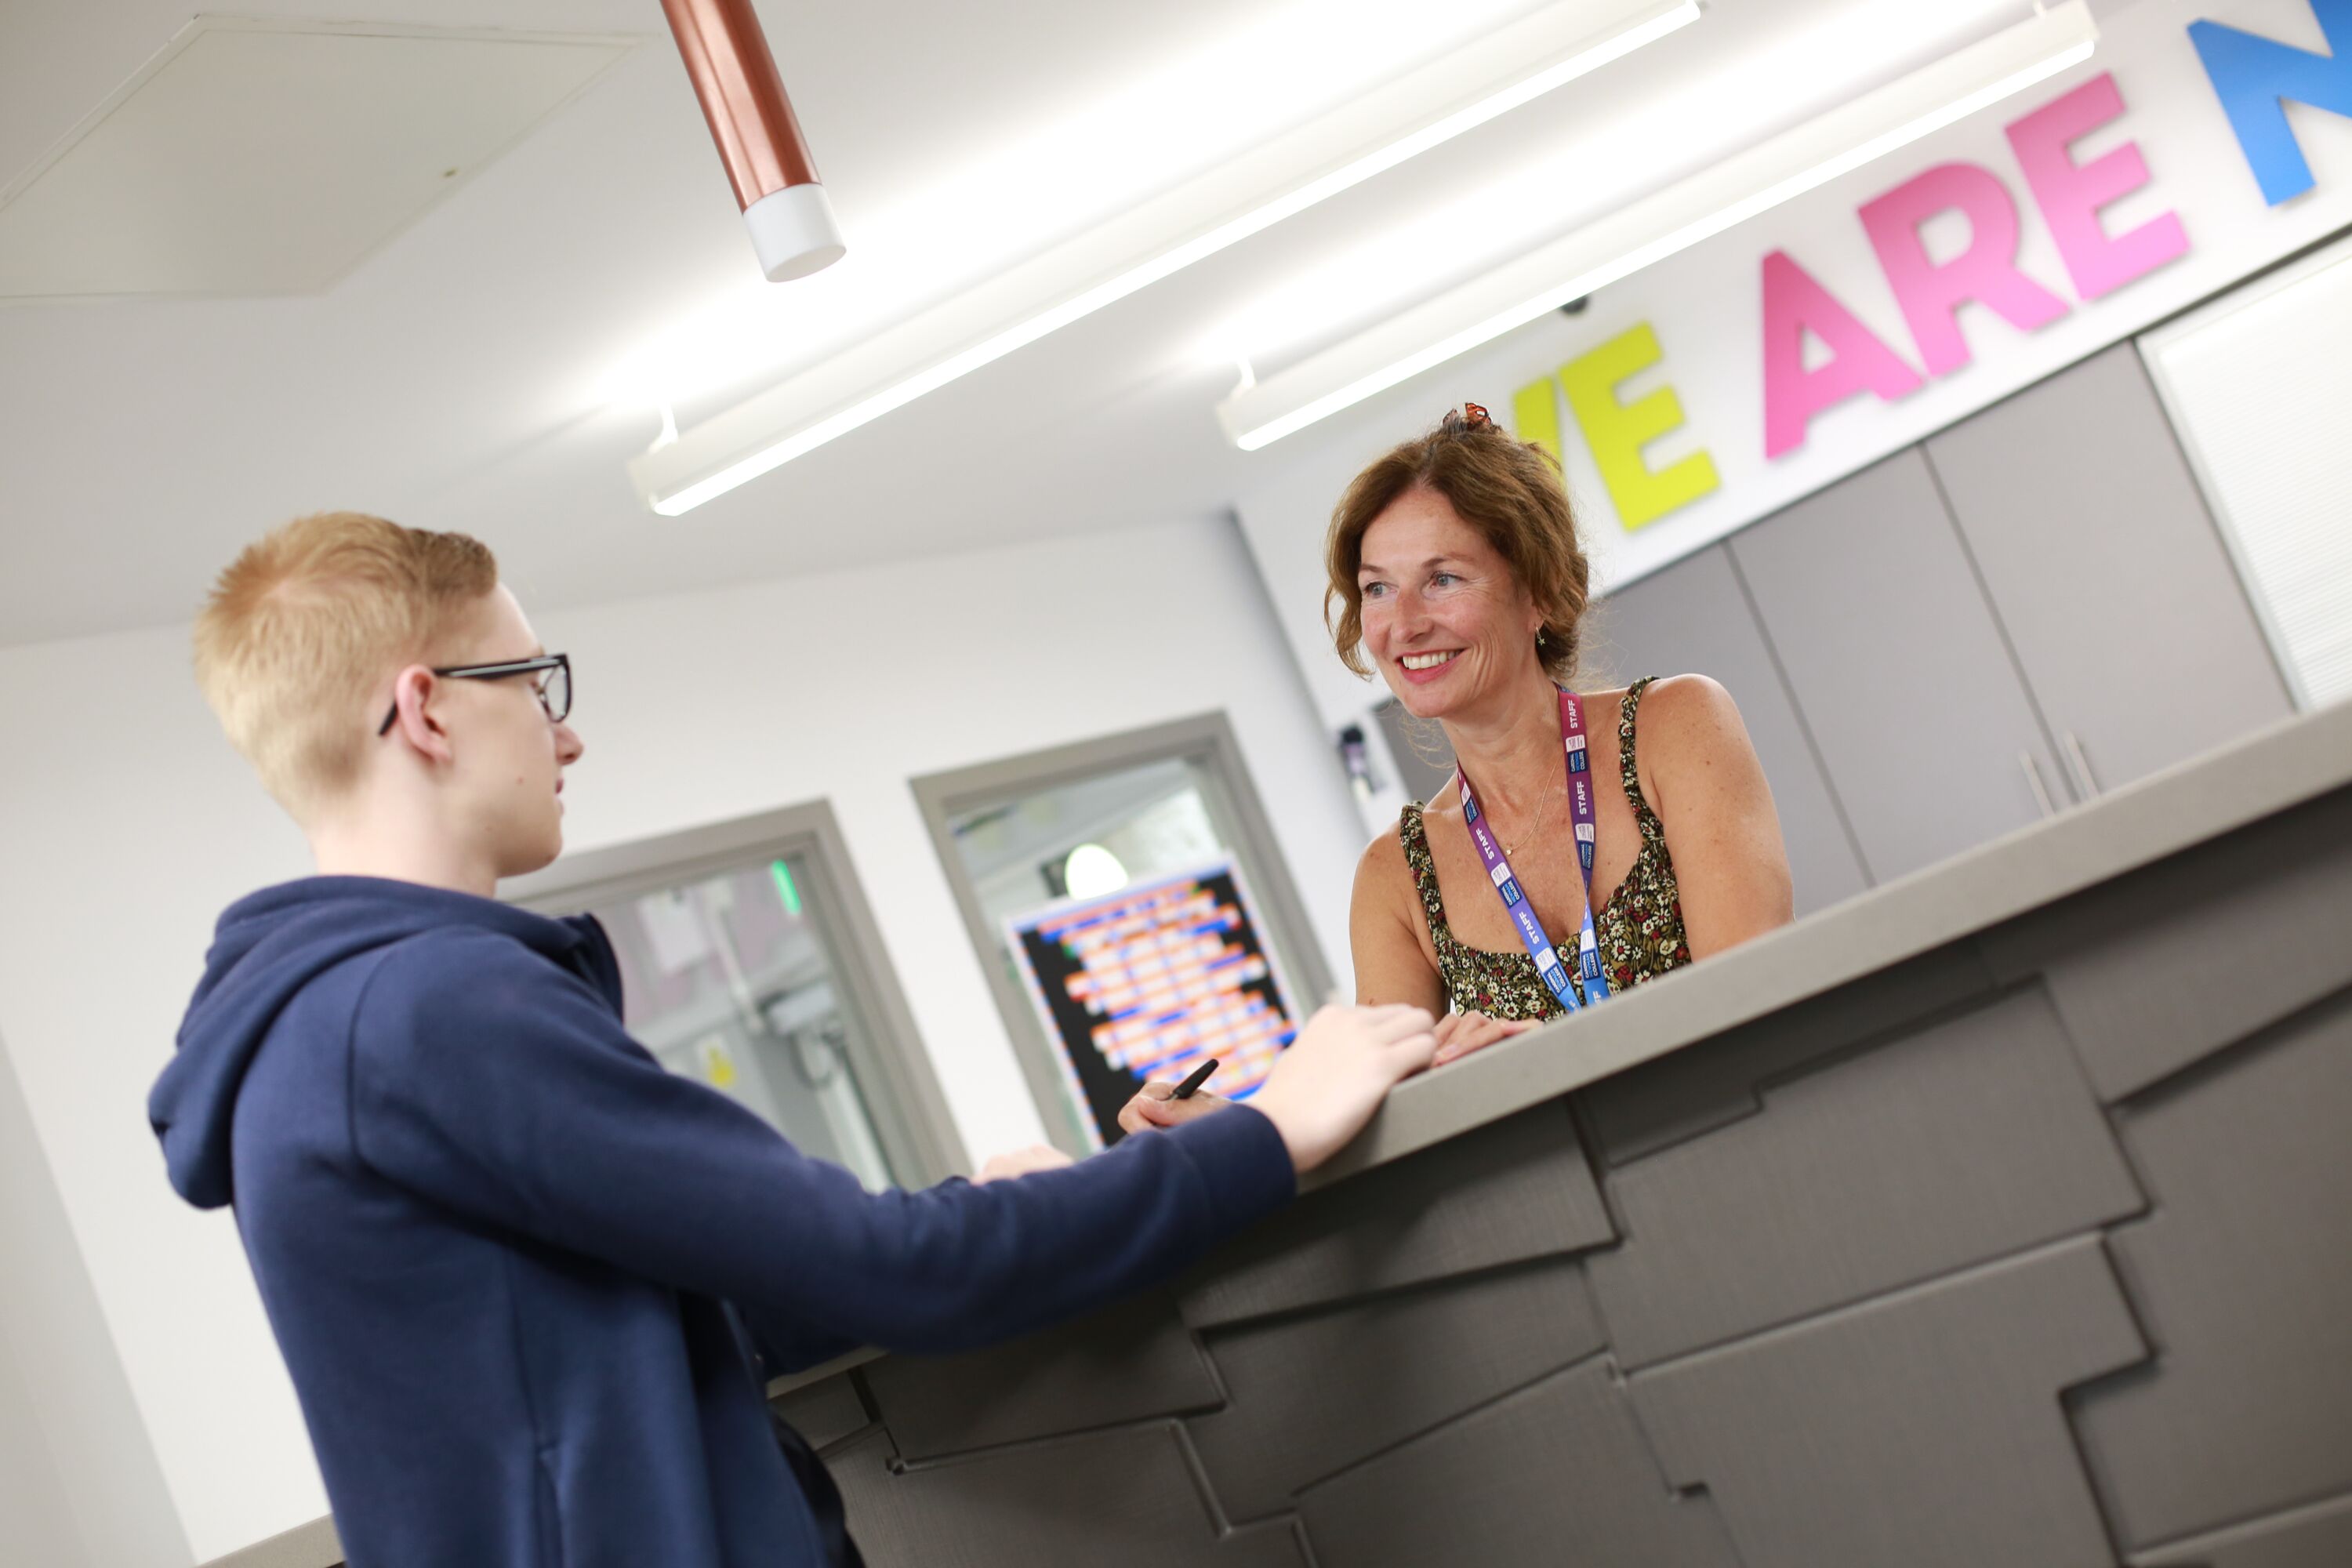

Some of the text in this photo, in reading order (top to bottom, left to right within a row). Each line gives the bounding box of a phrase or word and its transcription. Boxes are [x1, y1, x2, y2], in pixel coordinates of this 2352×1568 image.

[1761, 71, 2190, 461] ARE
[1567, 699, 1578, 729] STAFF
[1577, 781, 1587, 815] STAFF
[1475, 828, 1495, 860] STAFF
[1501, 886, 1513, 906] CARDINAL
[1504, 883, 1516, 902] NEWMAN
[1508, 880, 1520, 900] COLLEGE
[1519, 911, 1540, 945] STAFF
[1590, 952, 1599, 976] COLLEGE
[1547, 971, 1560, 993] CARDINAL
[1551, 969, 1563, 990] NEWMAN
[1554, 966, 1566, 987] COLLEGE
